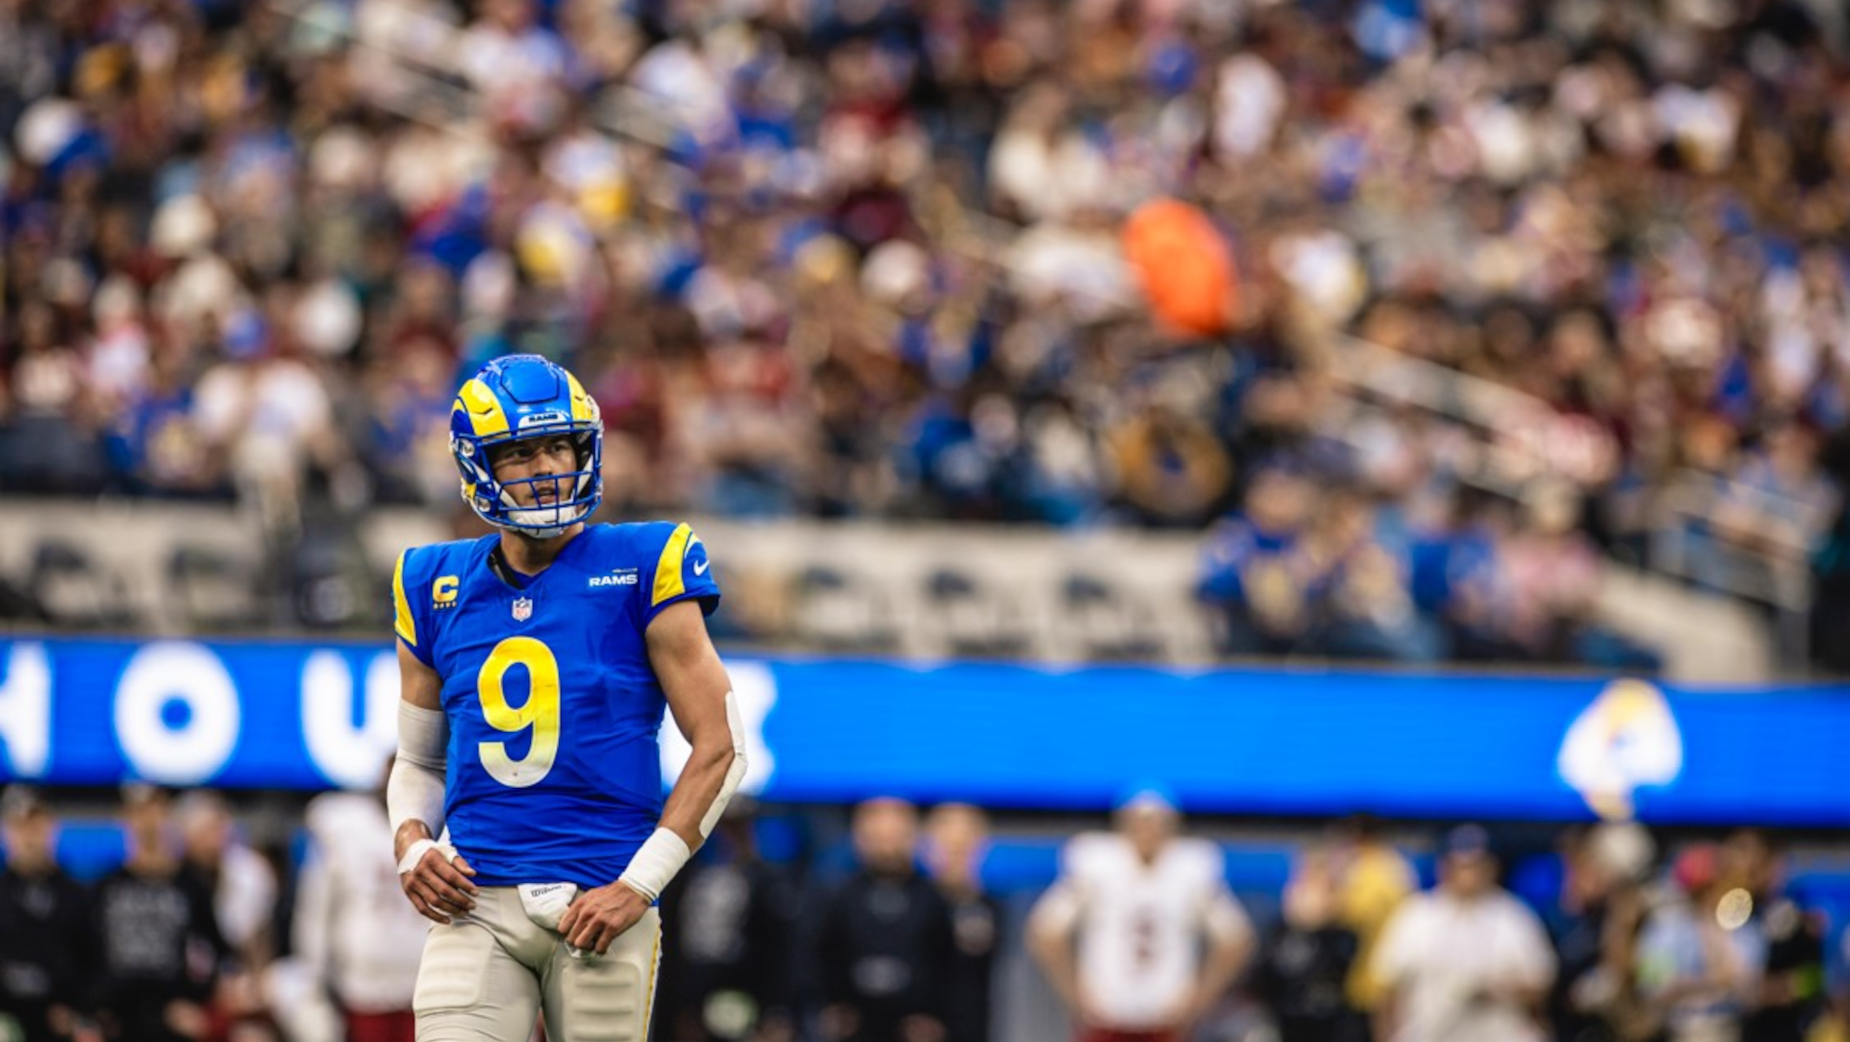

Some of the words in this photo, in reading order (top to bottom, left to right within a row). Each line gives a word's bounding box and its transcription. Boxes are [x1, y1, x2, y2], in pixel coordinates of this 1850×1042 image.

[432, 575, 459, 602] C
[589, 573, 639, 588] RAMS
[477, 635, 561, 789] 9
